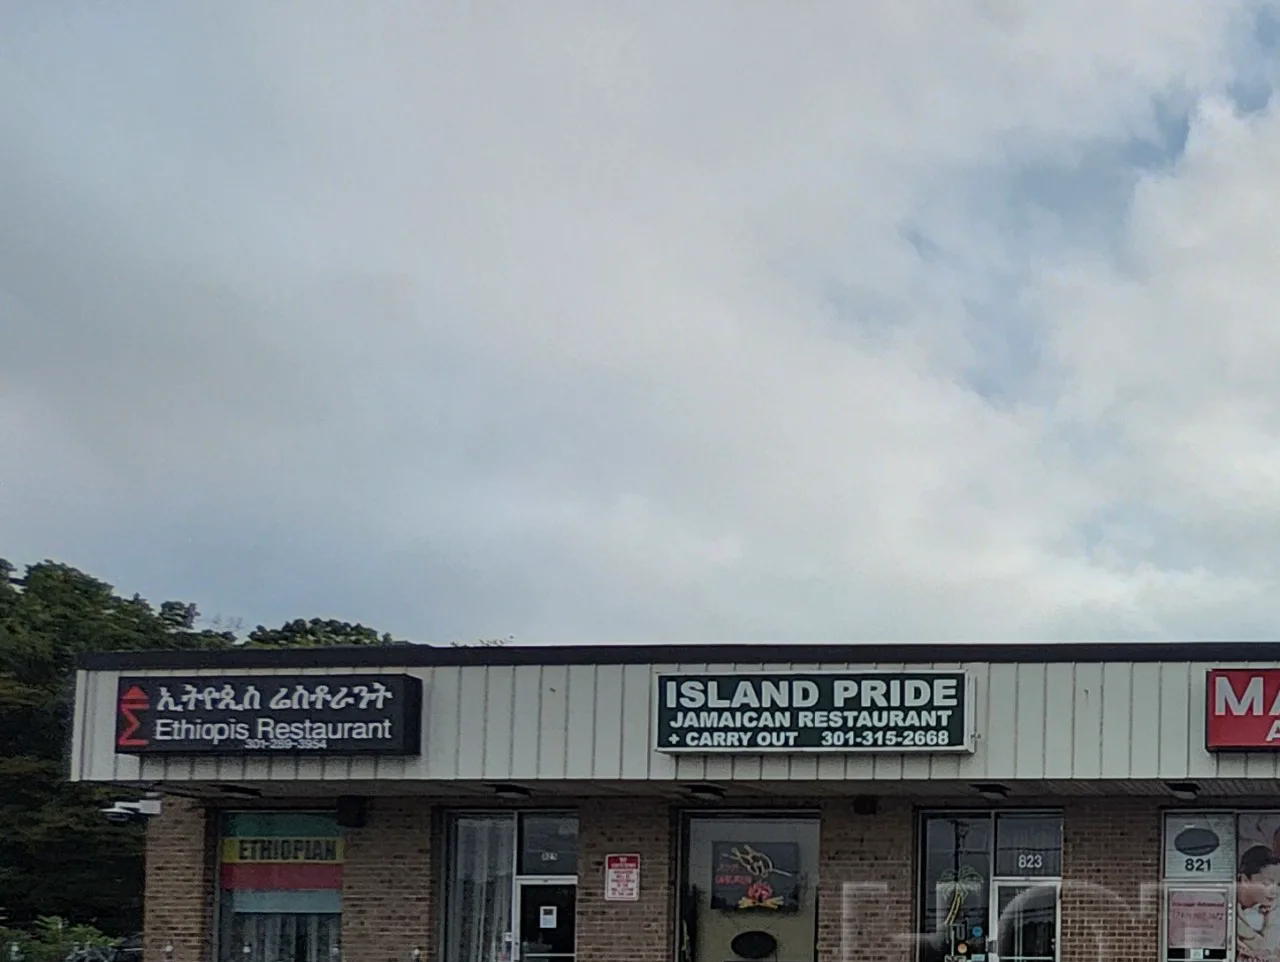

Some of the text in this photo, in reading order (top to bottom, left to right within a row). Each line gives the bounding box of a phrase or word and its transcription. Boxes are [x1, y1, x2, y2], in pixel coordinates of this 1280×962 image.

[666, 679, 958, 708] ISLAND PRIDE
[669, 710, 952, 728] JAMAICAN RESTAURANT
[155, 717, 393, 745] Ethiopis Restaurant
[685, 731, 752, 746] CARRY
[756, 731, 799, 746] OUT
[821, 730, 949, 746] 301-315-2668
[1018, 854, 1043, 868] 823
[1184, 858, 1212, 872] 821
